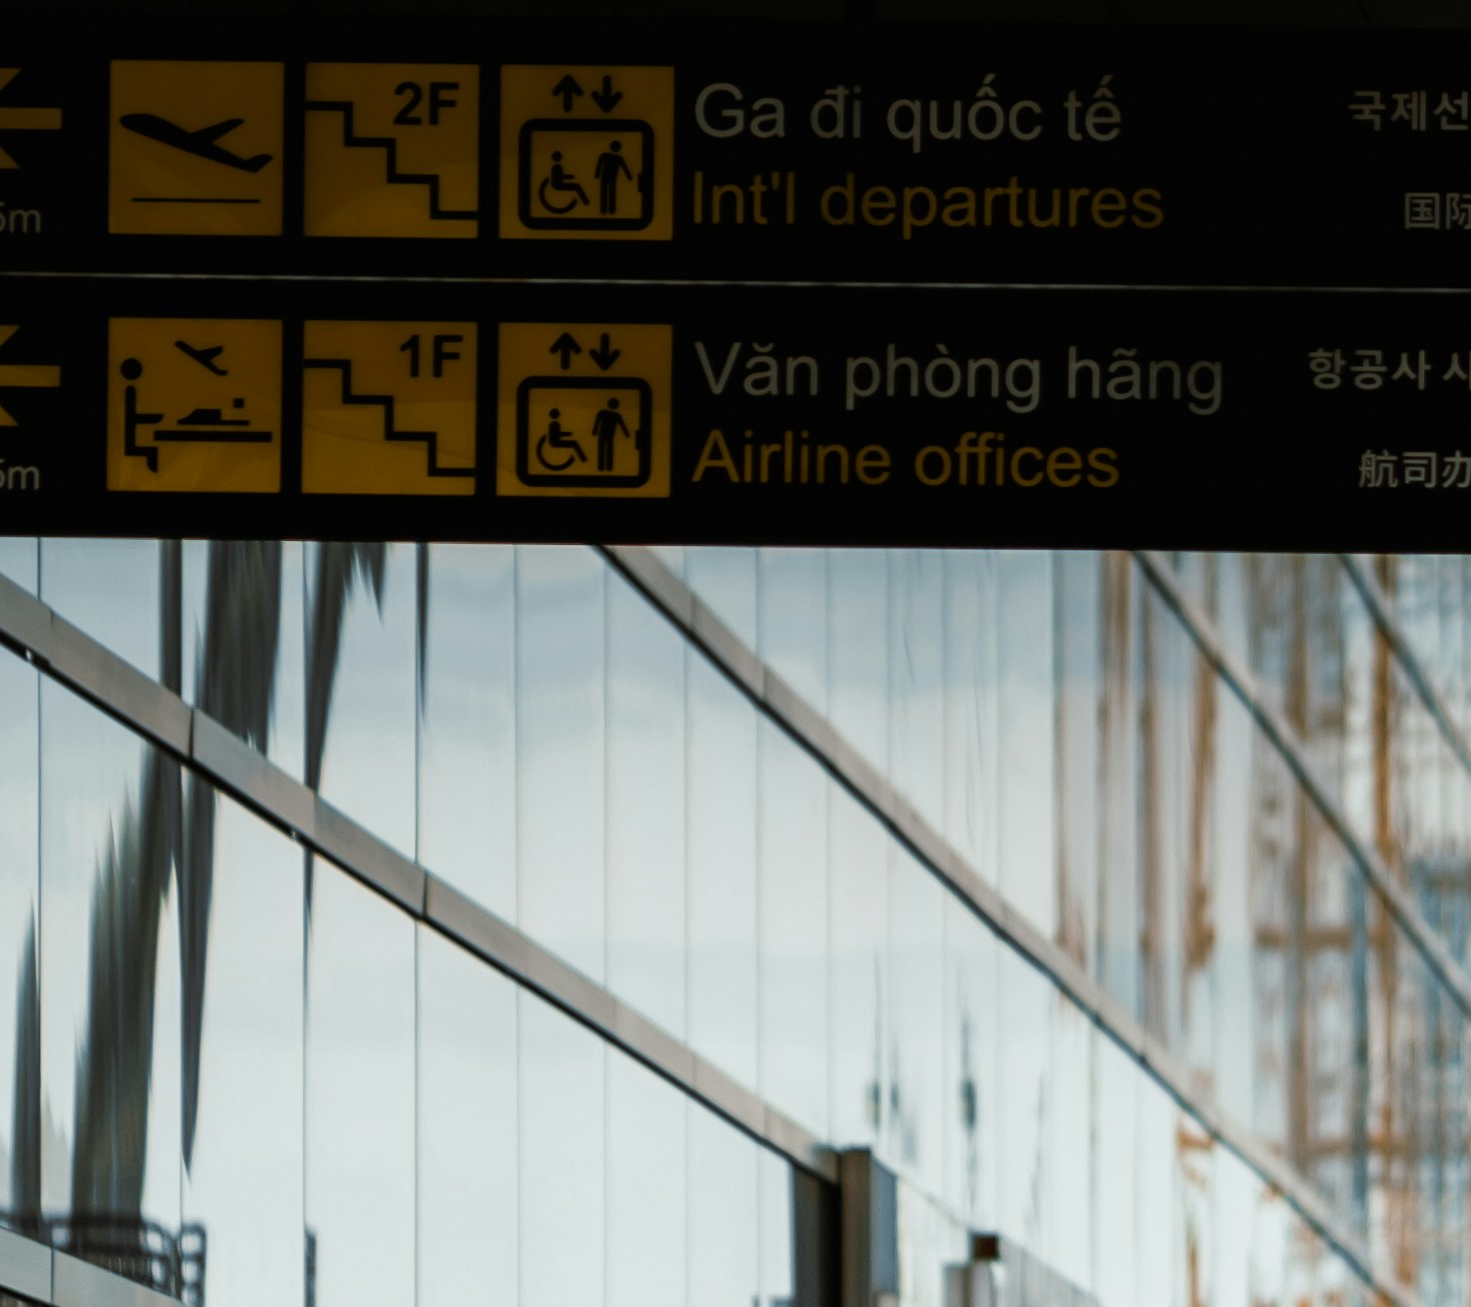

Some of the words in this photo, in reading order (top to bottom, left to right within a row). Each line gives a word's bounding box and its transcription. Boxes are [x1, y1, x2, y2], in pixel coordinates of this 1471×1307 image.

[394, 82, 459, 125] 2F
[694, 82, 786, 139] Ga
[809, 85, 863, 139] đi
[886, 73, 1043, 154] quốc
[1064, 74, 1123, 142] tế
[1346, 90, 1471, 133] 국제선
[692, 170, 796, 225] Int'l
[819, 171, 1164, 241] departures
[399, 335, 463, 377] 1F
[693, 341, 819, 397] Văn
[845, 343, 1043, 415] phòng
[1067, 346, 1224, 416] hãng
[1307, 348, 1431, 392] 항공사
[691, 429, 892, 485] Airline
[914, 431, 1121, 489] offices
